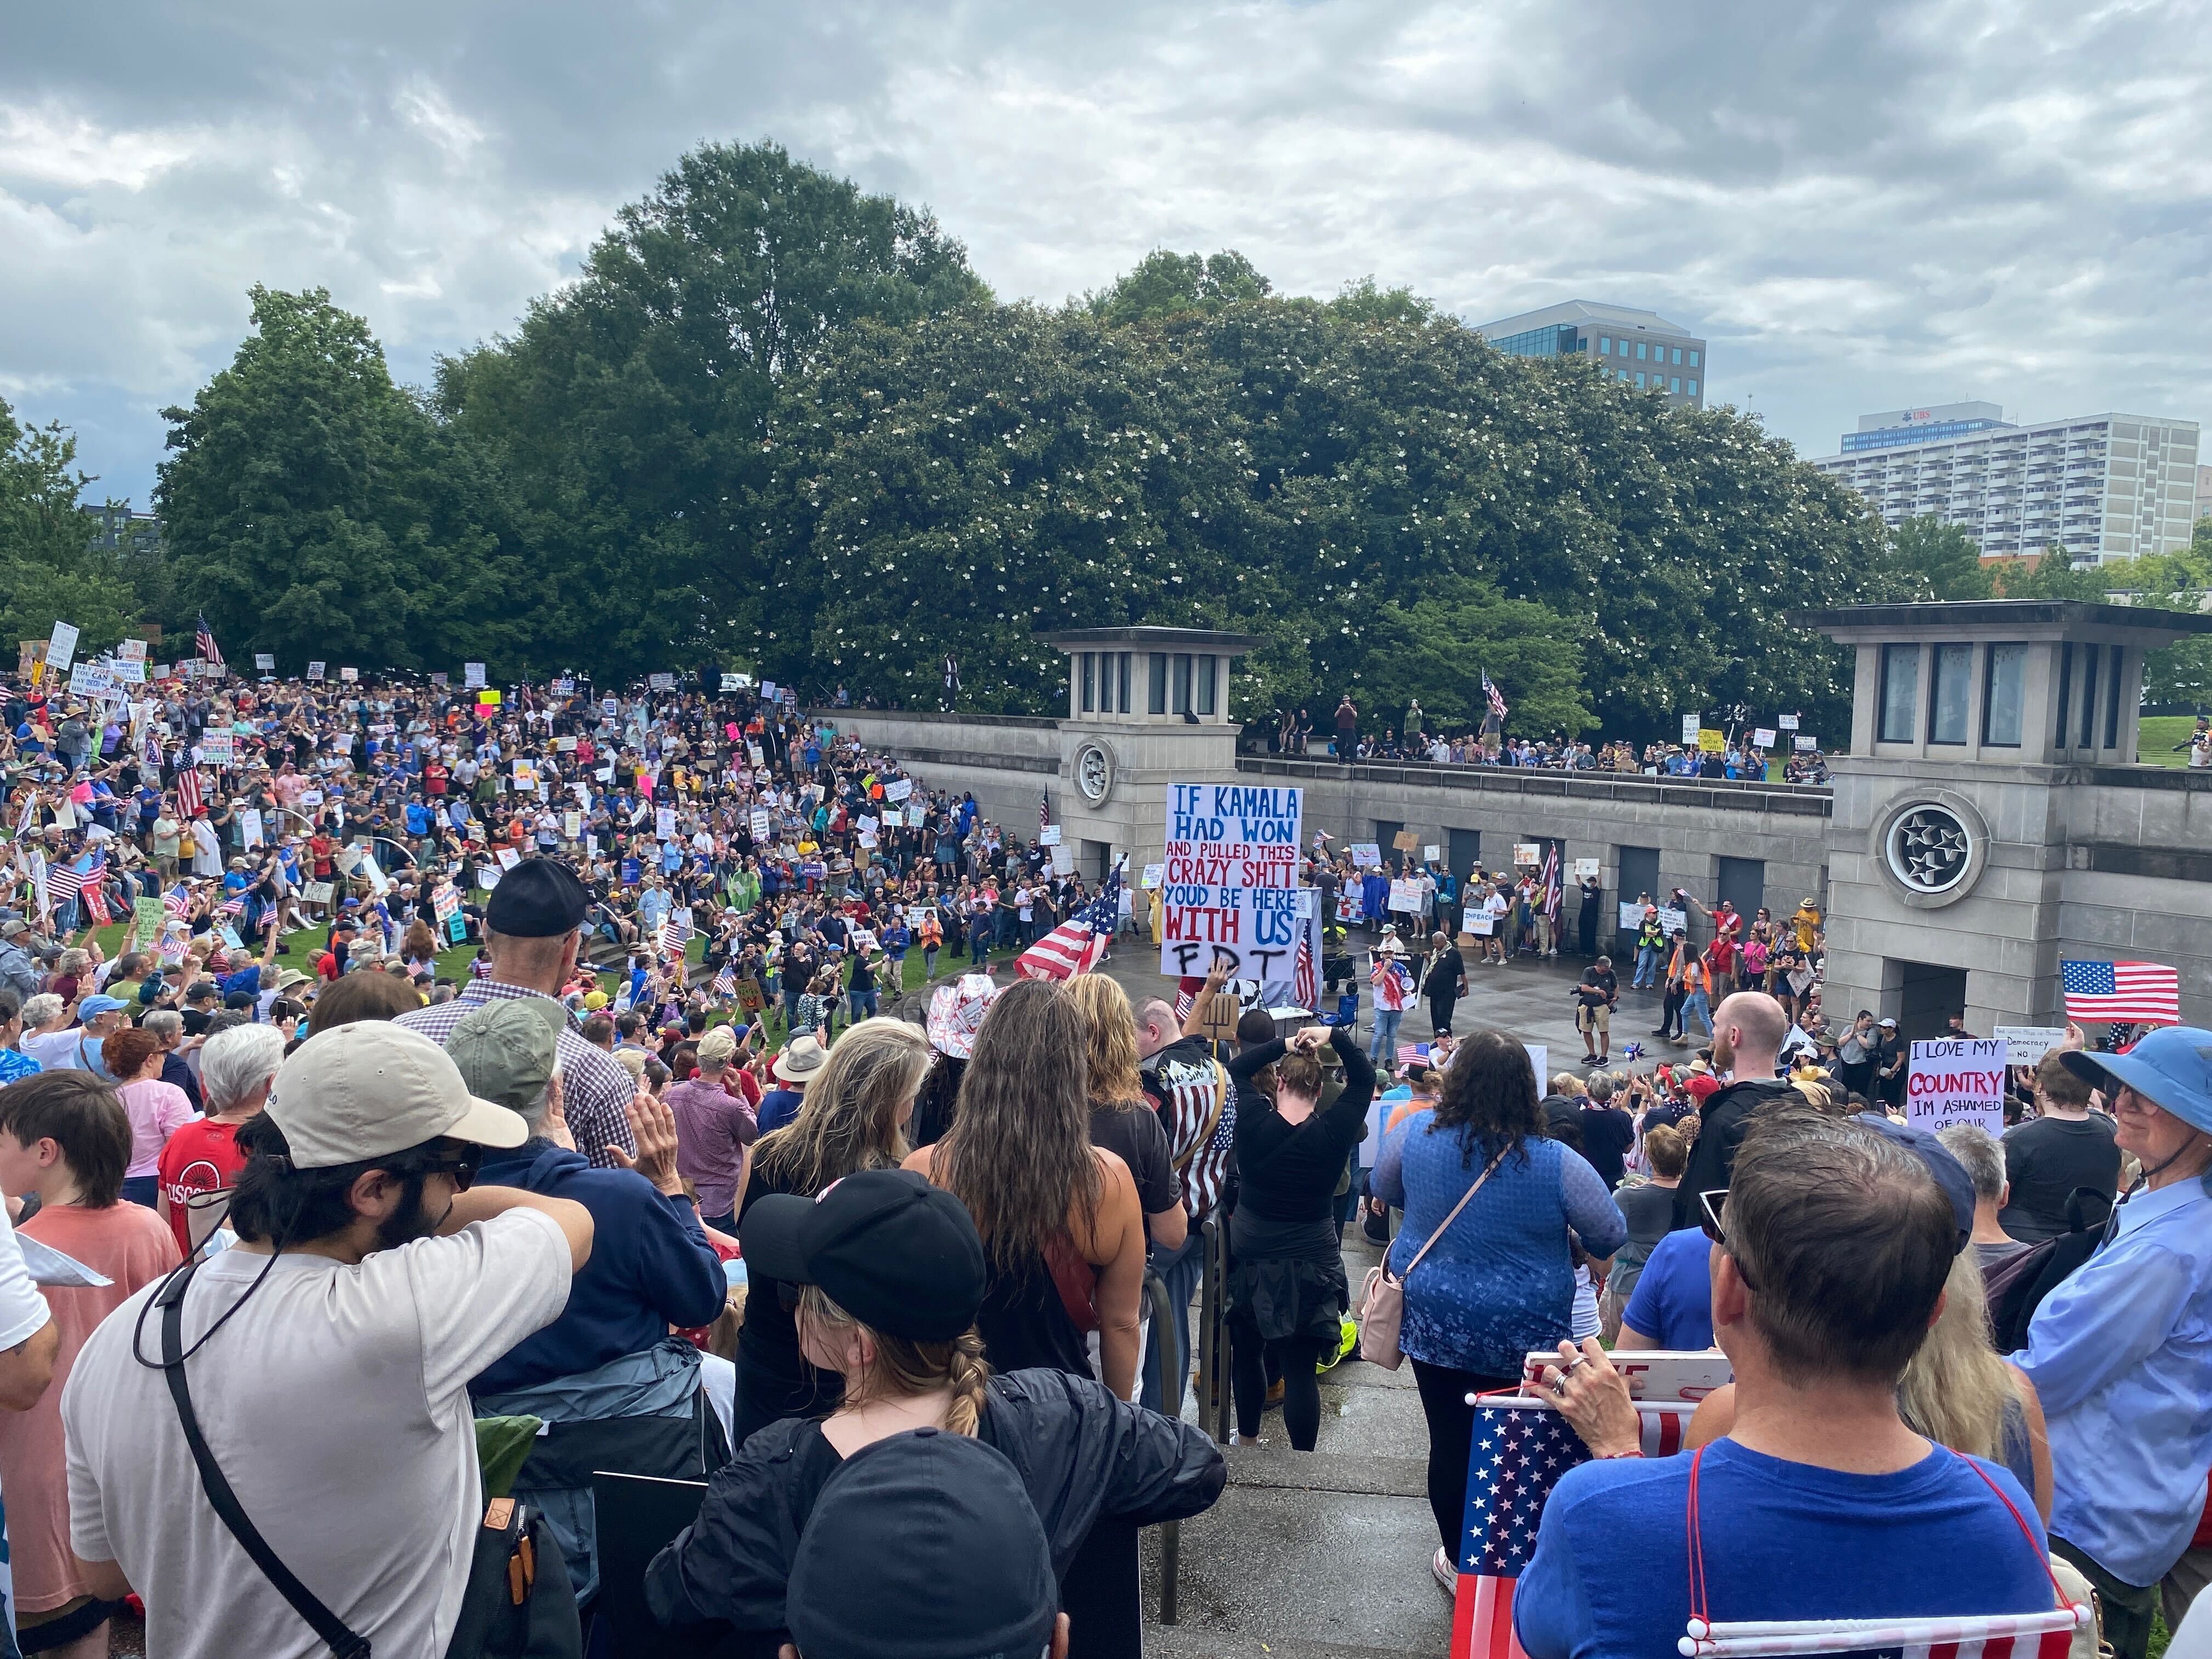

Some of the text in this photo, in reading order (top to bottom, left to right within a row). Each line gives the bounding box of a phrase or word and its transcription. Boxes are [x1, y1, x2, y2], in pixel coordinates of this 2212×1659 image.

[1913, 410, 1931, 420] UBS
[1174, 785, 1297, 819] IF KAMALA
[1175, 815, 1293, 843] HAD WON
[1166, 842, 1296, 860] AND PULLED THIS
[1169, 859, 1296, 888] CRAZY SHIT
[311, 884, 326, 893] FOR
[1221, 888, 1242, 909] BE
[1253, 889, 1297, 910] HERE
[1166, 906, 1293, 946] WITH US
[1912, 1040, 1999, 1060] I LOVE MY
[2007, 1037, 2049, 1050] Democracy
[1909, 1071, 2004, 1097] COUNTRY
[1914, 1099, 2001, 1116] I'M ASHAMED
[1934, 1120, 1952, 1130] OF
